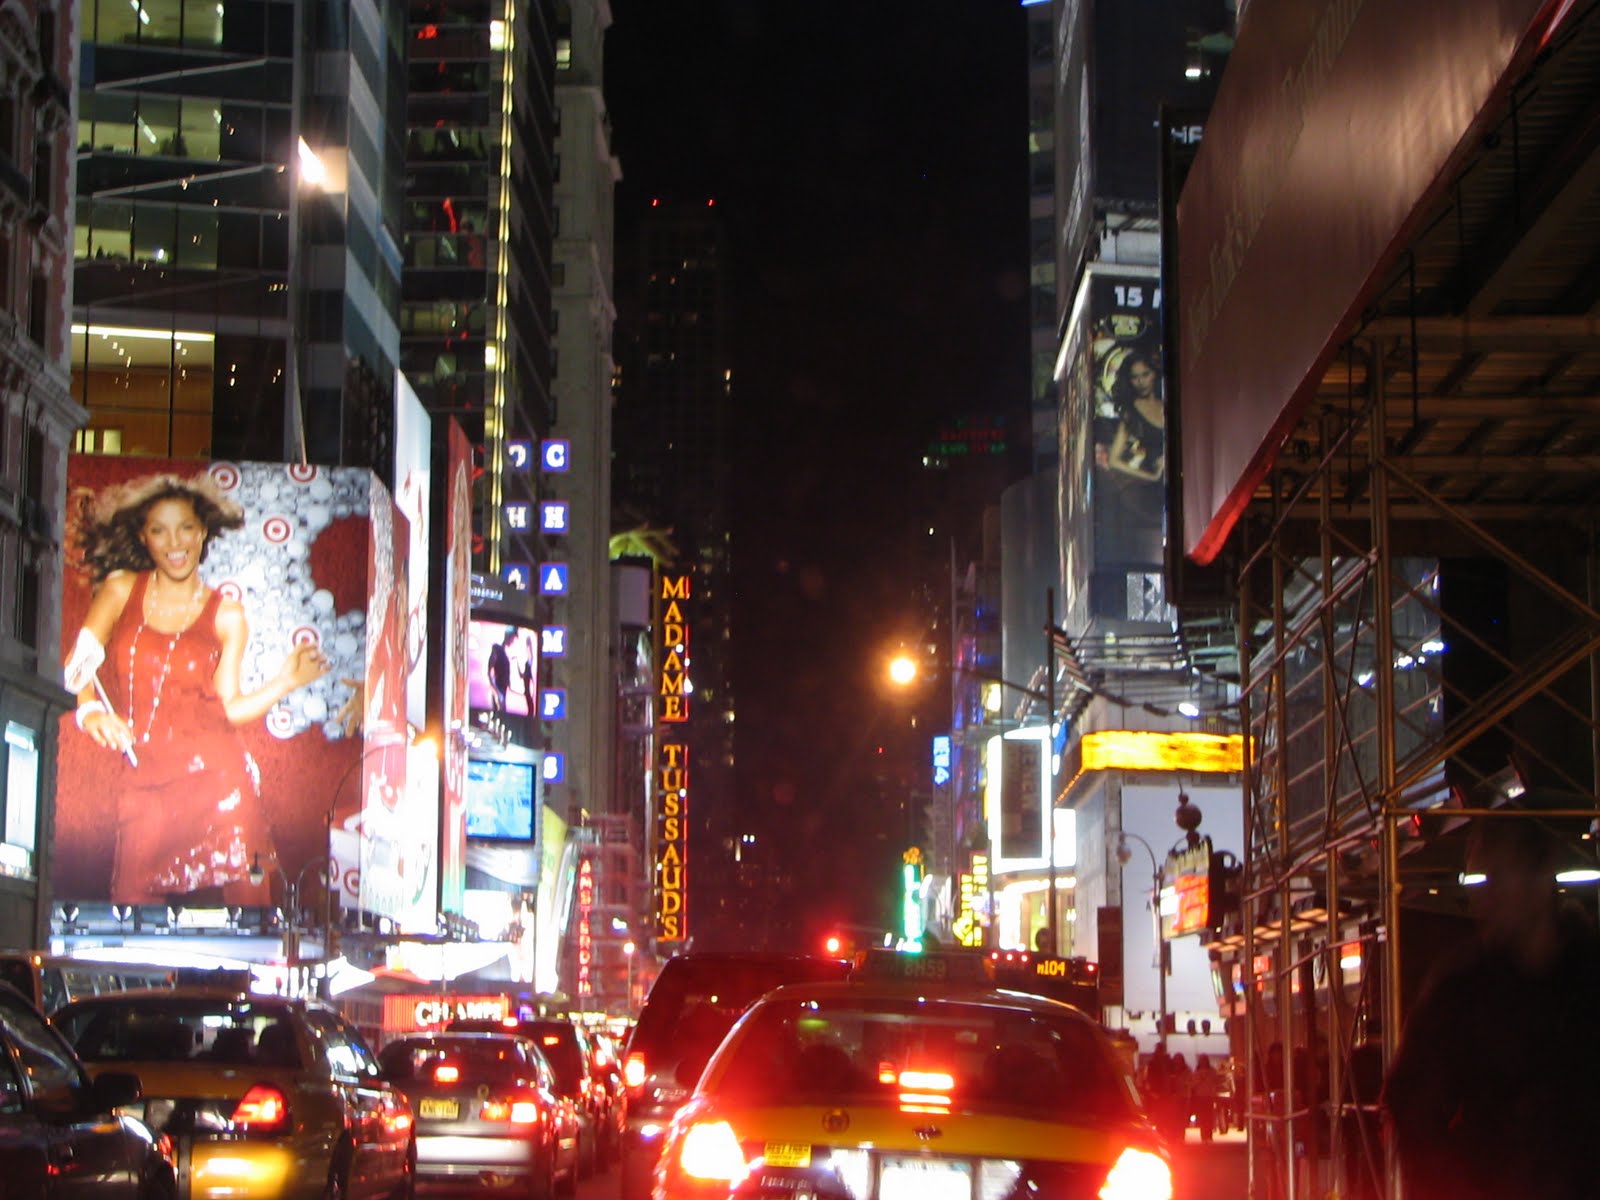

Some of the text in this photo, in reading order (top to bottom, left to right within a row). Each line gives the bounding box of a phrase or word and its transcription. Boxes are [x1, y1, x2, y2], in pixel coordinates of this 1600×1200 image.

[1114, 285, 1143, 308] 15
[541, 444, 565, 780] CHAMPS
[660, 575, 685, 719] MADAME
